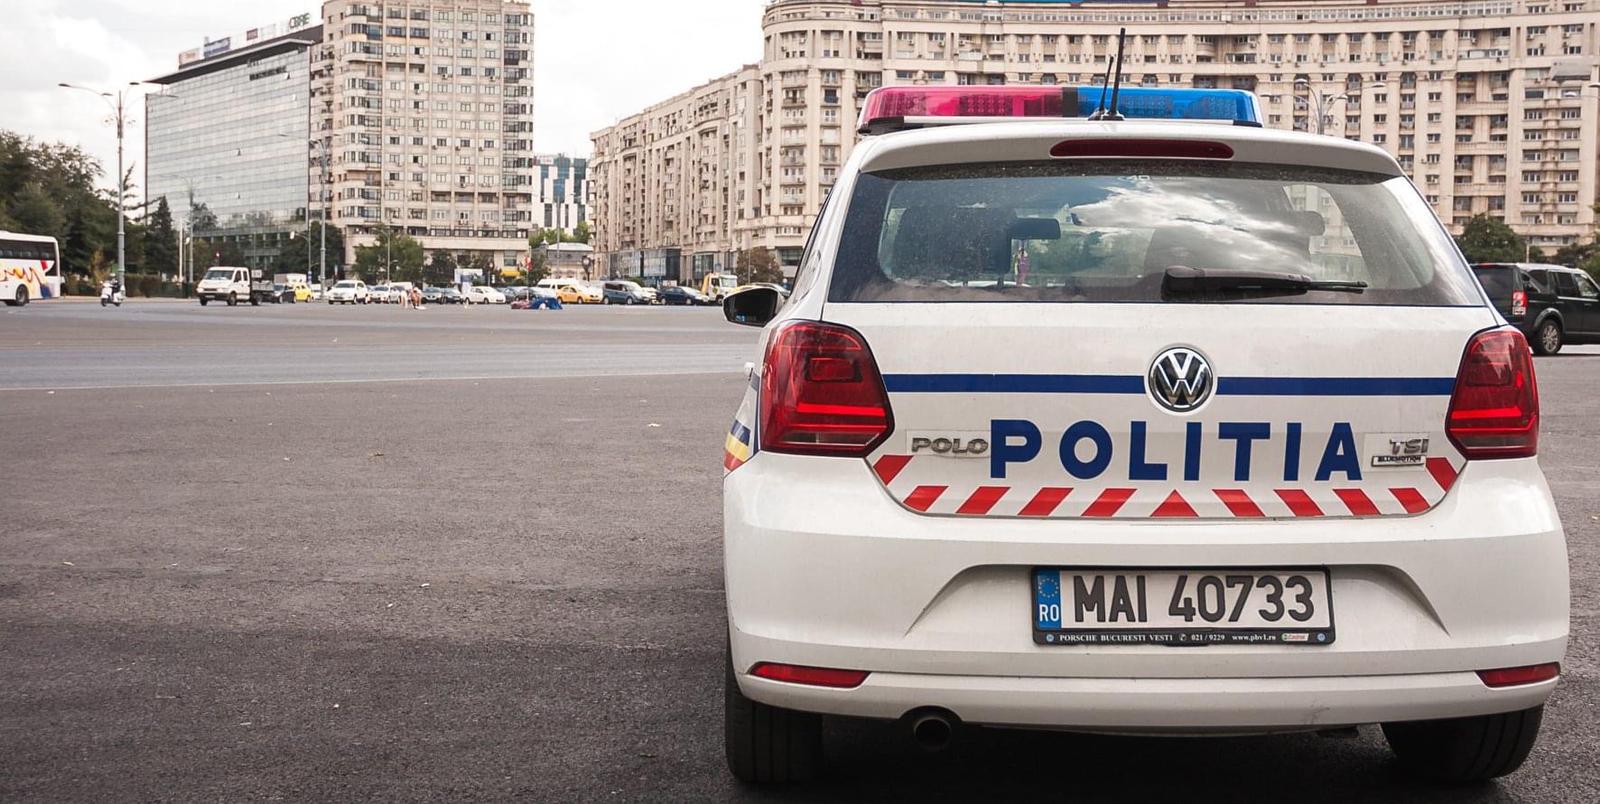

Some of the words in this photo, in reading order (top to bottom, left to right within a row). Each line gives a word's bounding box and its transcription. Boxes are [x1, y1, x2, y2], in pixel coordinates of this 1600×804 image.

[288, 12, 310, 29] CBRE
[911, 437, 989, 454] POLO
[990, 419, 1363, 481] POLITIA
[1389, 438, 1429, 455] TSI
[1073, 575, 1148, 622] MAI
[1168, 575, 1314, 622] 40733
[1039, 604, 1059, 622] RO
[1059, 634, 1097, 642] PORSCHE
[1101, 634, 1146, 642] BUCURESTI
